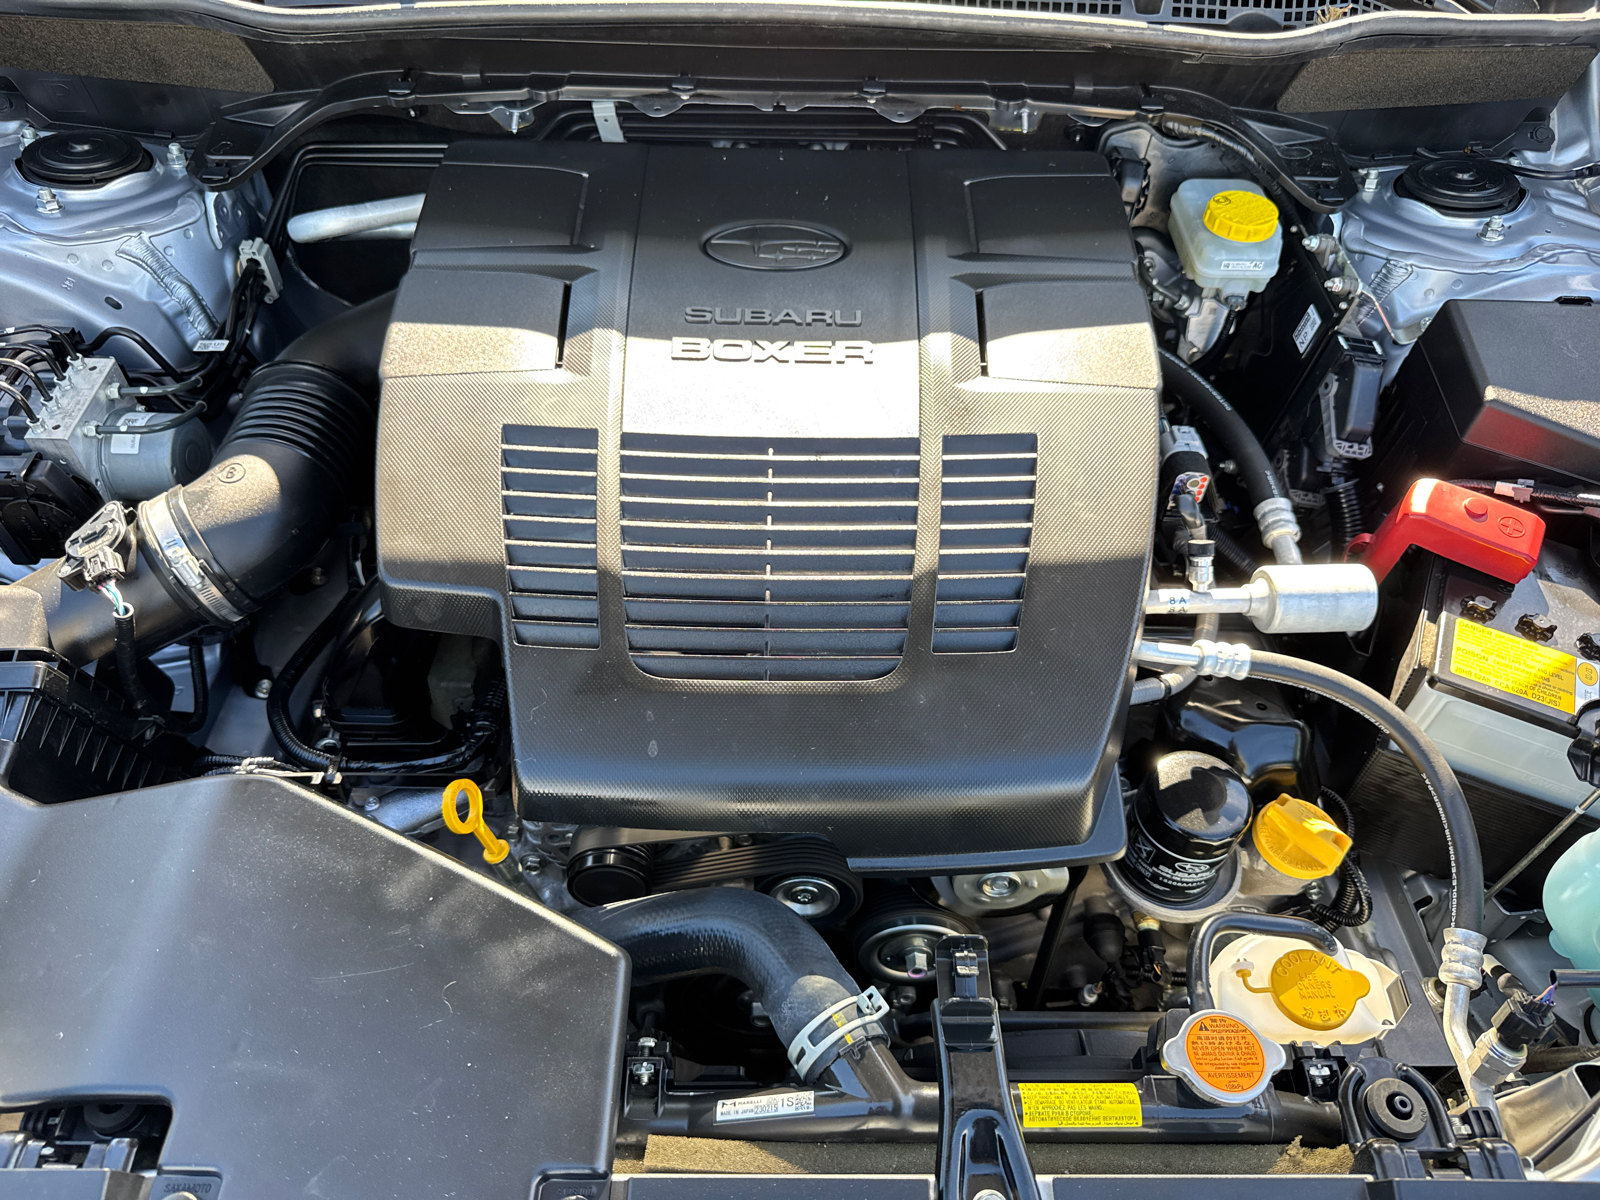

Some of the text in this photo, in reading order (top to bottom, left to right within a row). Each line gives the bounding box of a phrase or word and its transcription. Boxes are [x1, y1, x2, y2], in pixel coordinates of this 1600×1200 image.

[684, 306, 863, 328] SUBARU
[671, 336, 874, 365] BOXER
[1458, 621, 1493, 636] DANGER
[1456, 646, 1489, 662] POISON
[1534, 673, 1550, 683] BURNS
[1549, 671, 1564, 681] LEVEL
[1454, 666, 1473, 678] 20HR
[1495, 679, 1510, 690] CCA
[1511, 685, 1529, 697] 620A
[1532, 692, 1560, 708] D23(JIS)
[1537, 688, 1562, 701] CHILDREN
[1521, 773, 1571, 796] LOWER
[1158, 864, 1216, 878] SUBARU
[1276, 952, 1342, 977] COOLANT
[1298, 972, 1318, 981] SEE
[1296, 980, 1332, 991] OWNERS
[1299, 989, 1336, 1000] MANUAL
[781, 1097, 794, 1107] 1S
